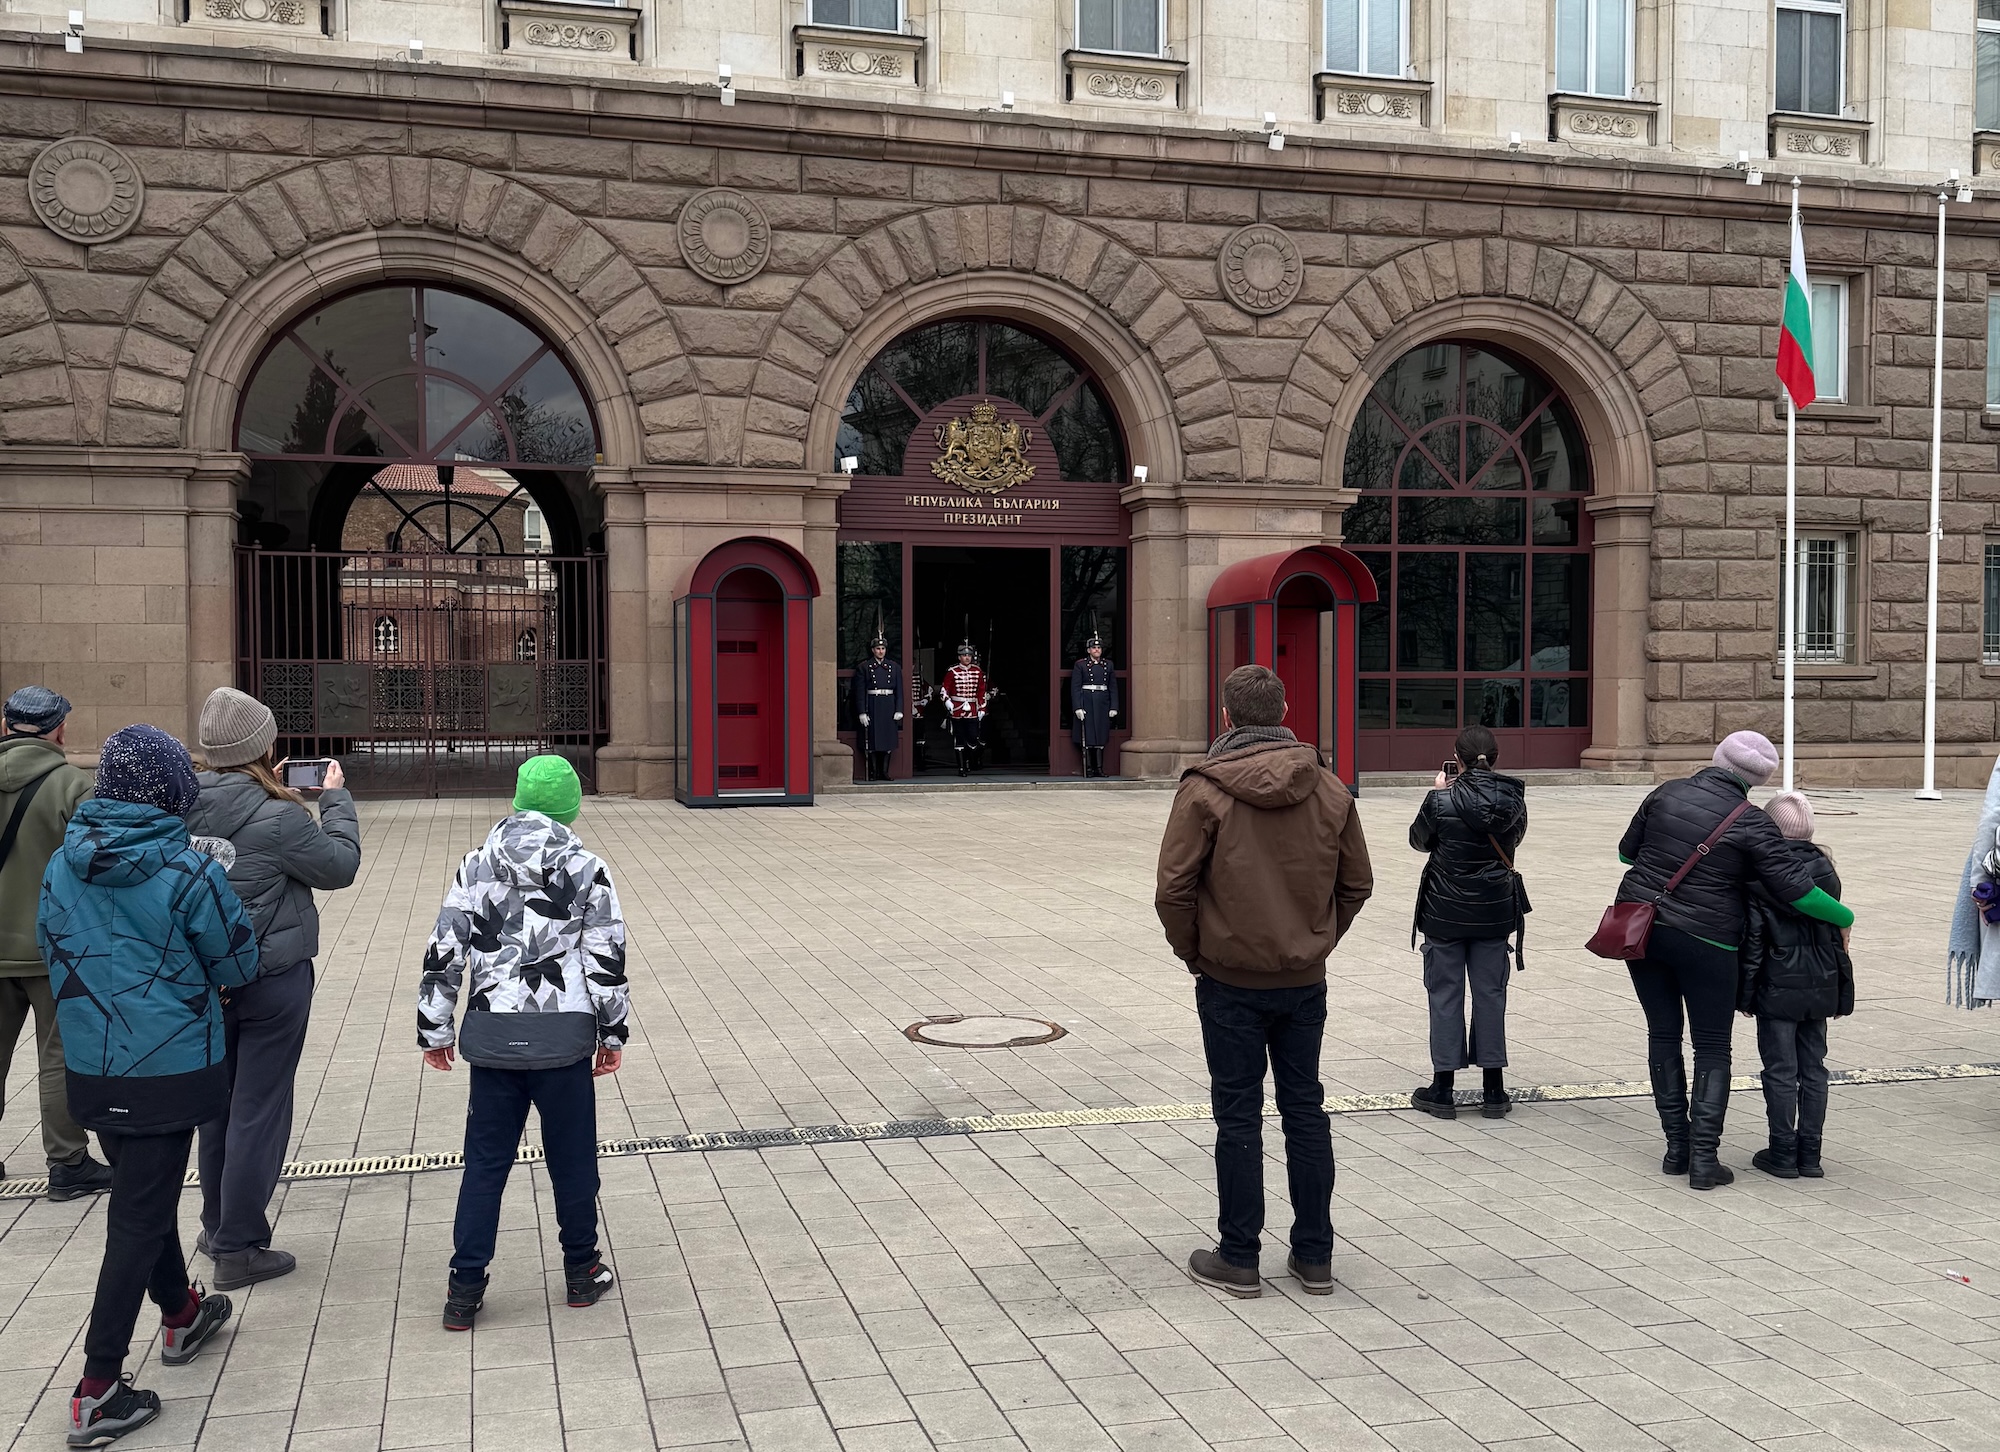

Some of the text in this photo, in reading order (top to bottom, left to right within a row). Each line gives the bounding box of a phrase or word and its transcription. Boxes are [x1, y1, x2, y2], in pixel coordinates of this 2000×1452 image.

[905, 495, 1060, 510] РЕПУБЛИКА БЪЛГАРИЯ
[944, 513, 1023, 527] ПРЕЗИДЕНТ
